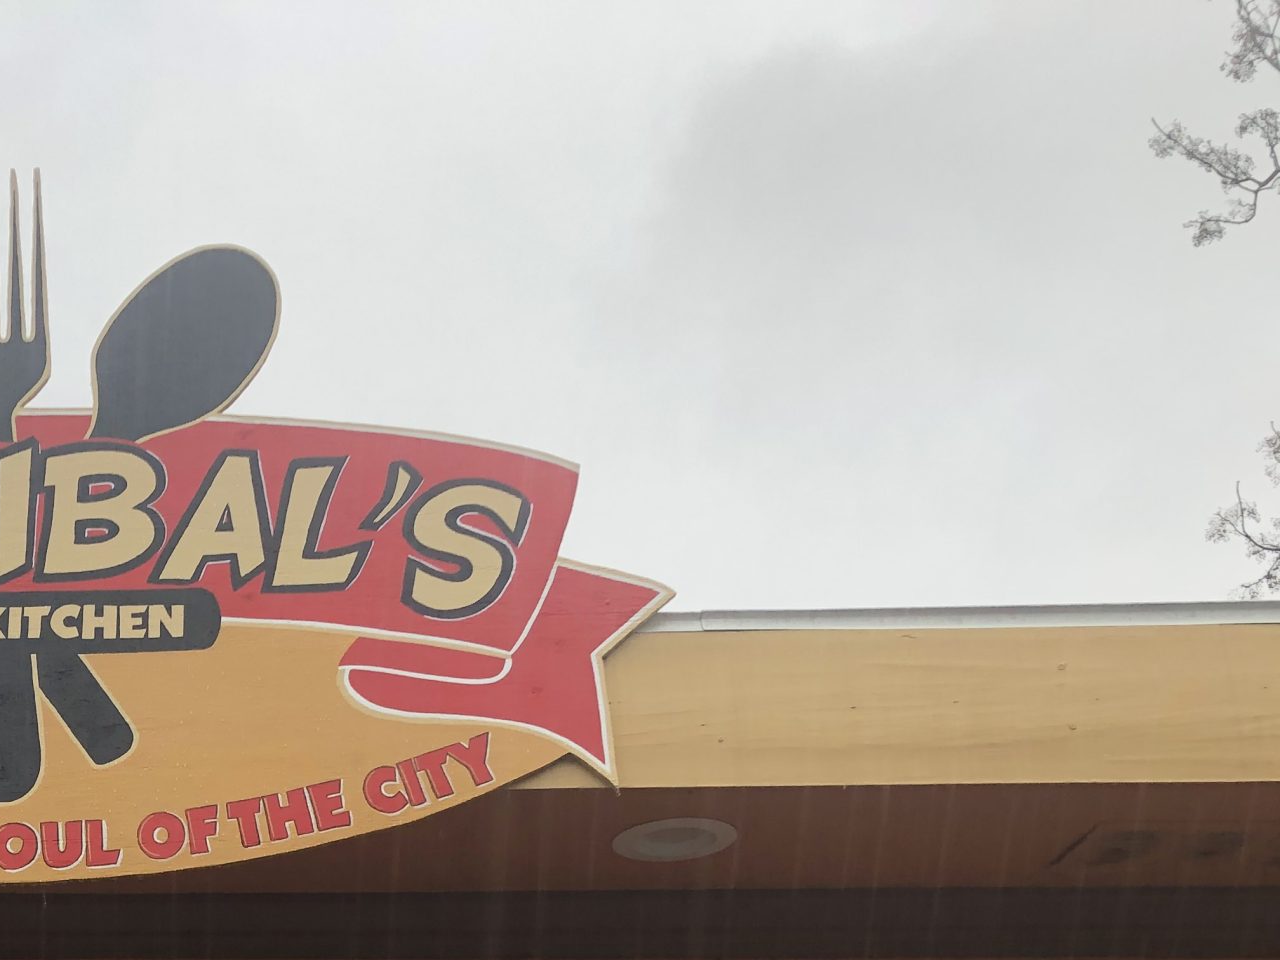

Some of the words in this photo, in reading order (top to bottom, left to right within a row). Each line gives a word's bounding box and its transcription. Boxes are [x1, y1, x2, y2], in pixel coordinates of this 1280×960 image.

[136, 803, 219, 860] OF
[226, 778, 352, 849] THE
[362, 731, 496, 815] CITY
